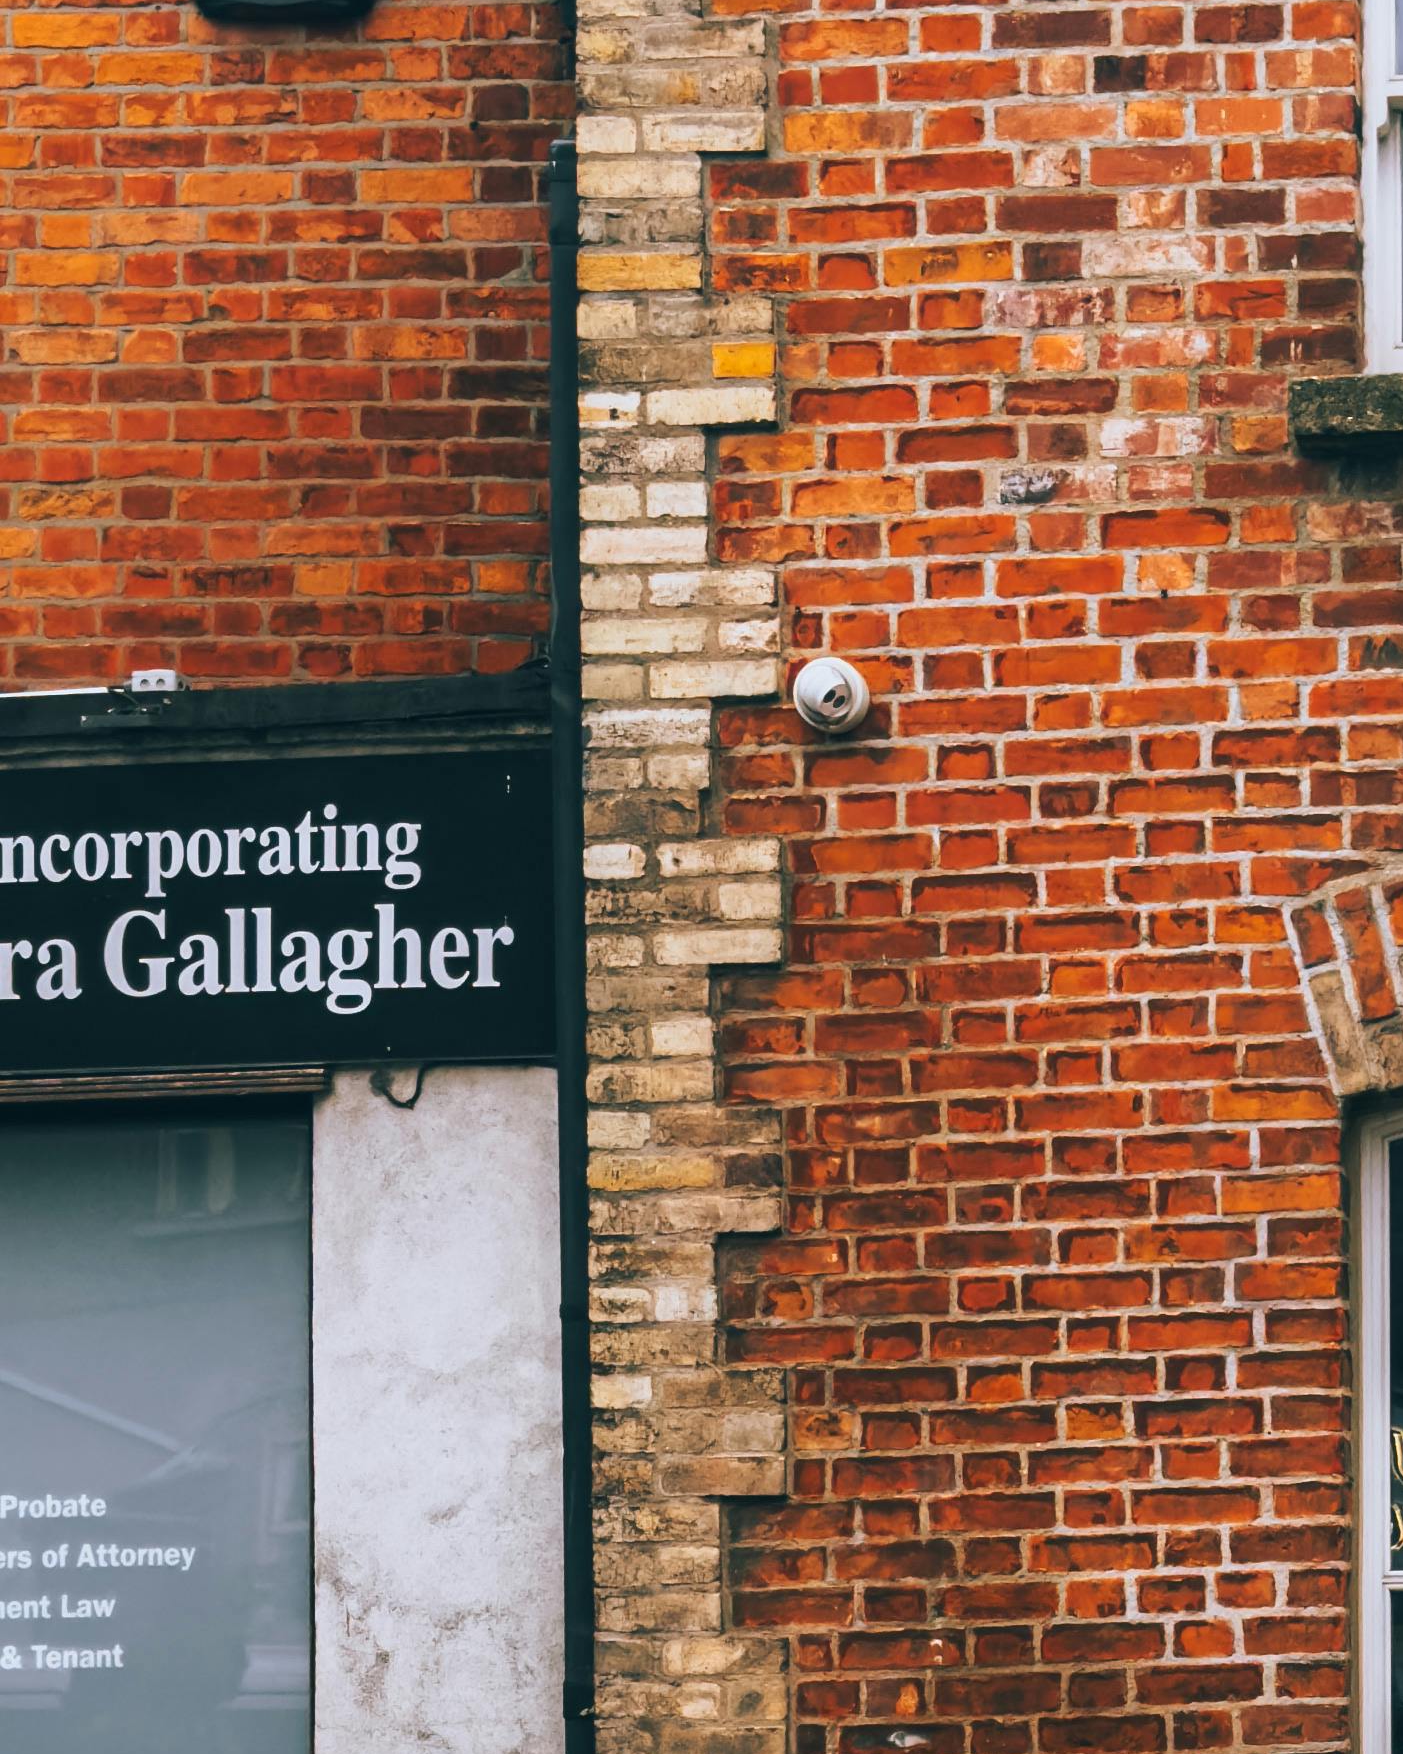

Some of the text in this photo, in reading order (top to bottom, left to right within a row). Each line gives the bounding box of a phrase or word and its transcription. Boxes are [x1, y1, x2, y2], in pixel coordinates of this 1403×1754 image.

[0, 803, 422, 897] ncorporating
[0, 903, 515, 1015] ra Gallagher
[0, 1493, 107, 1519] Probate
[42, 1543, 69, 1568] of
[76, 1543, 196, 1571] Attorney
[61, 1594, 116, 1618] Law
[30, 1644, 124, 1670] Tenant
